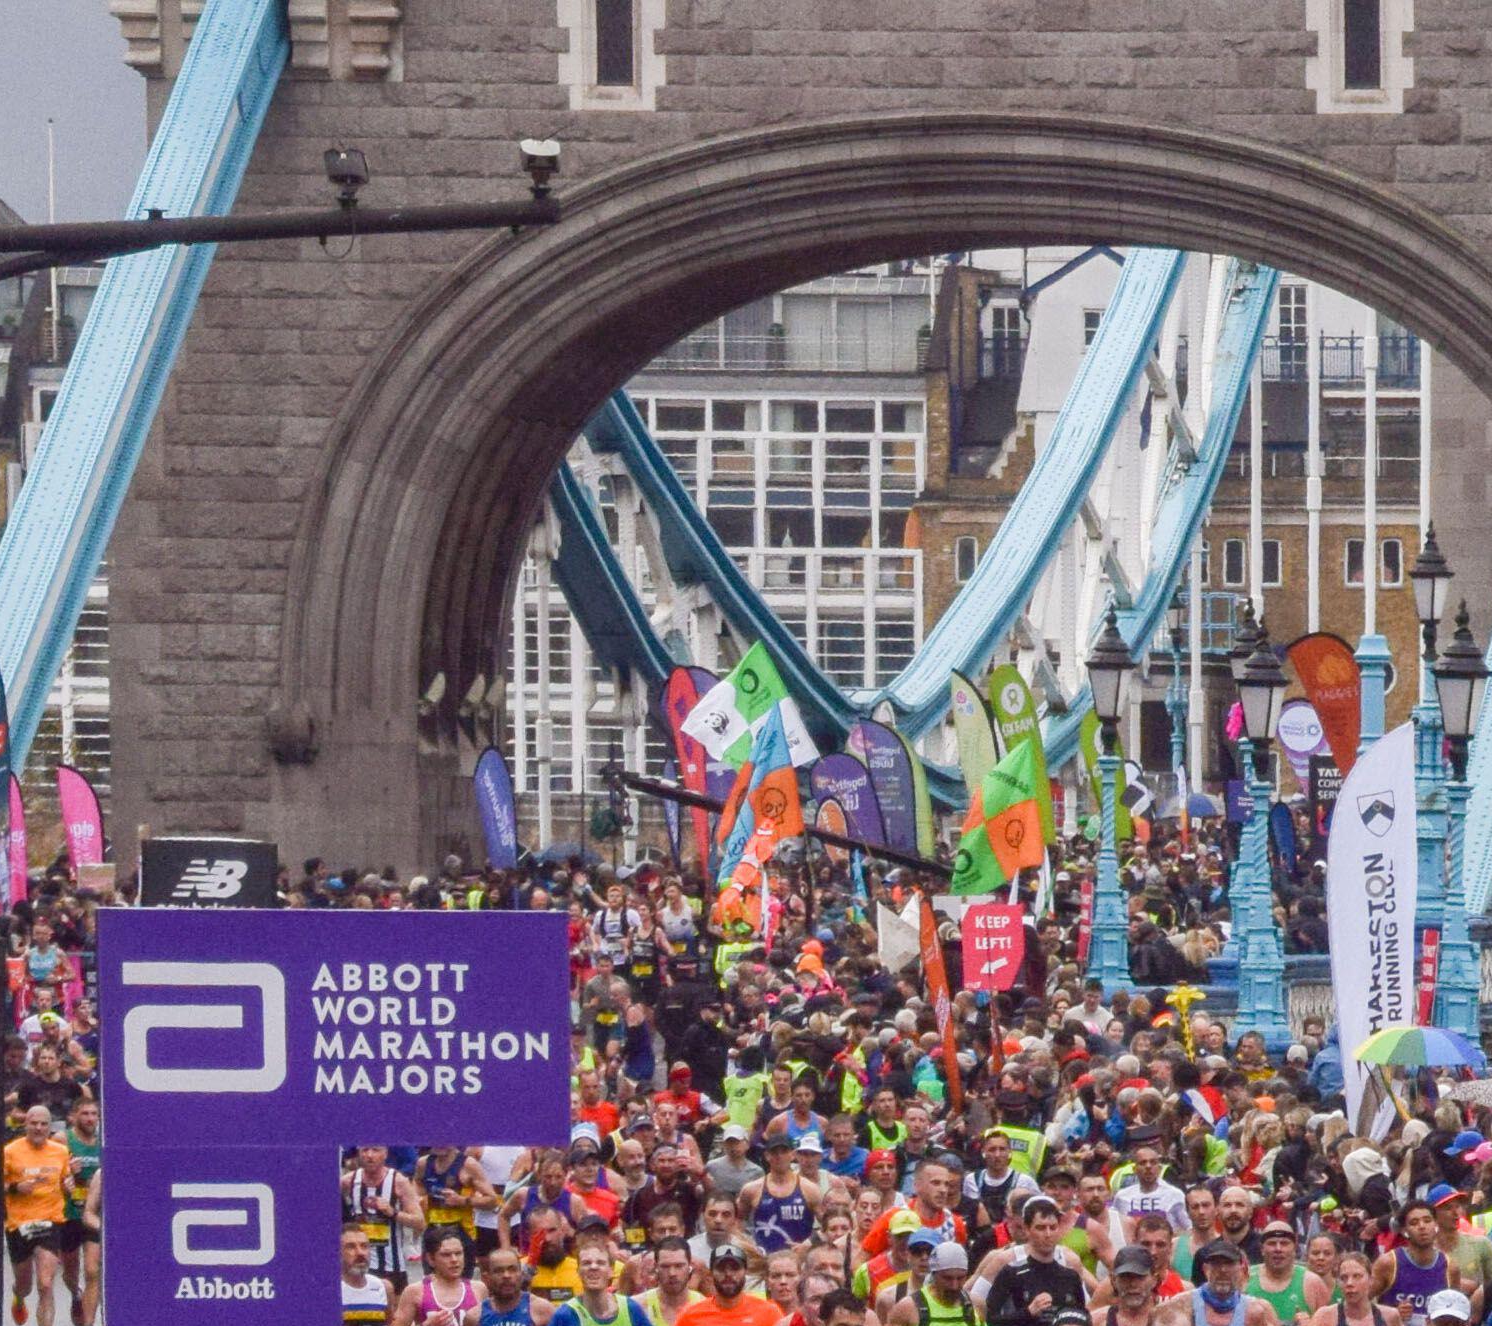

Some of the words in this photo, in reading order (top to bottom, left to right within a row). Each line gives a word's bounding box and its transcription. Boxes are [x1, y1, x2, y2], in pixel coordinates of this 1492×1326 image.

[975, 916, 1010, 929] KEEP
[975, 938, 1012, 950] LEFT!
[312, 963, 469, 992] ABBOTT
[1383, 923, 1402, 1021] RUNNING
[312, 998, 456, 1026] WORLD
[314, 1032, 551, 1061] MARATHON
[314, 1065, 483, 1095] MAJORS
[1129, 1198, 1160, 1212] LEE
[175, 1276, 275, 1300] Abbott
